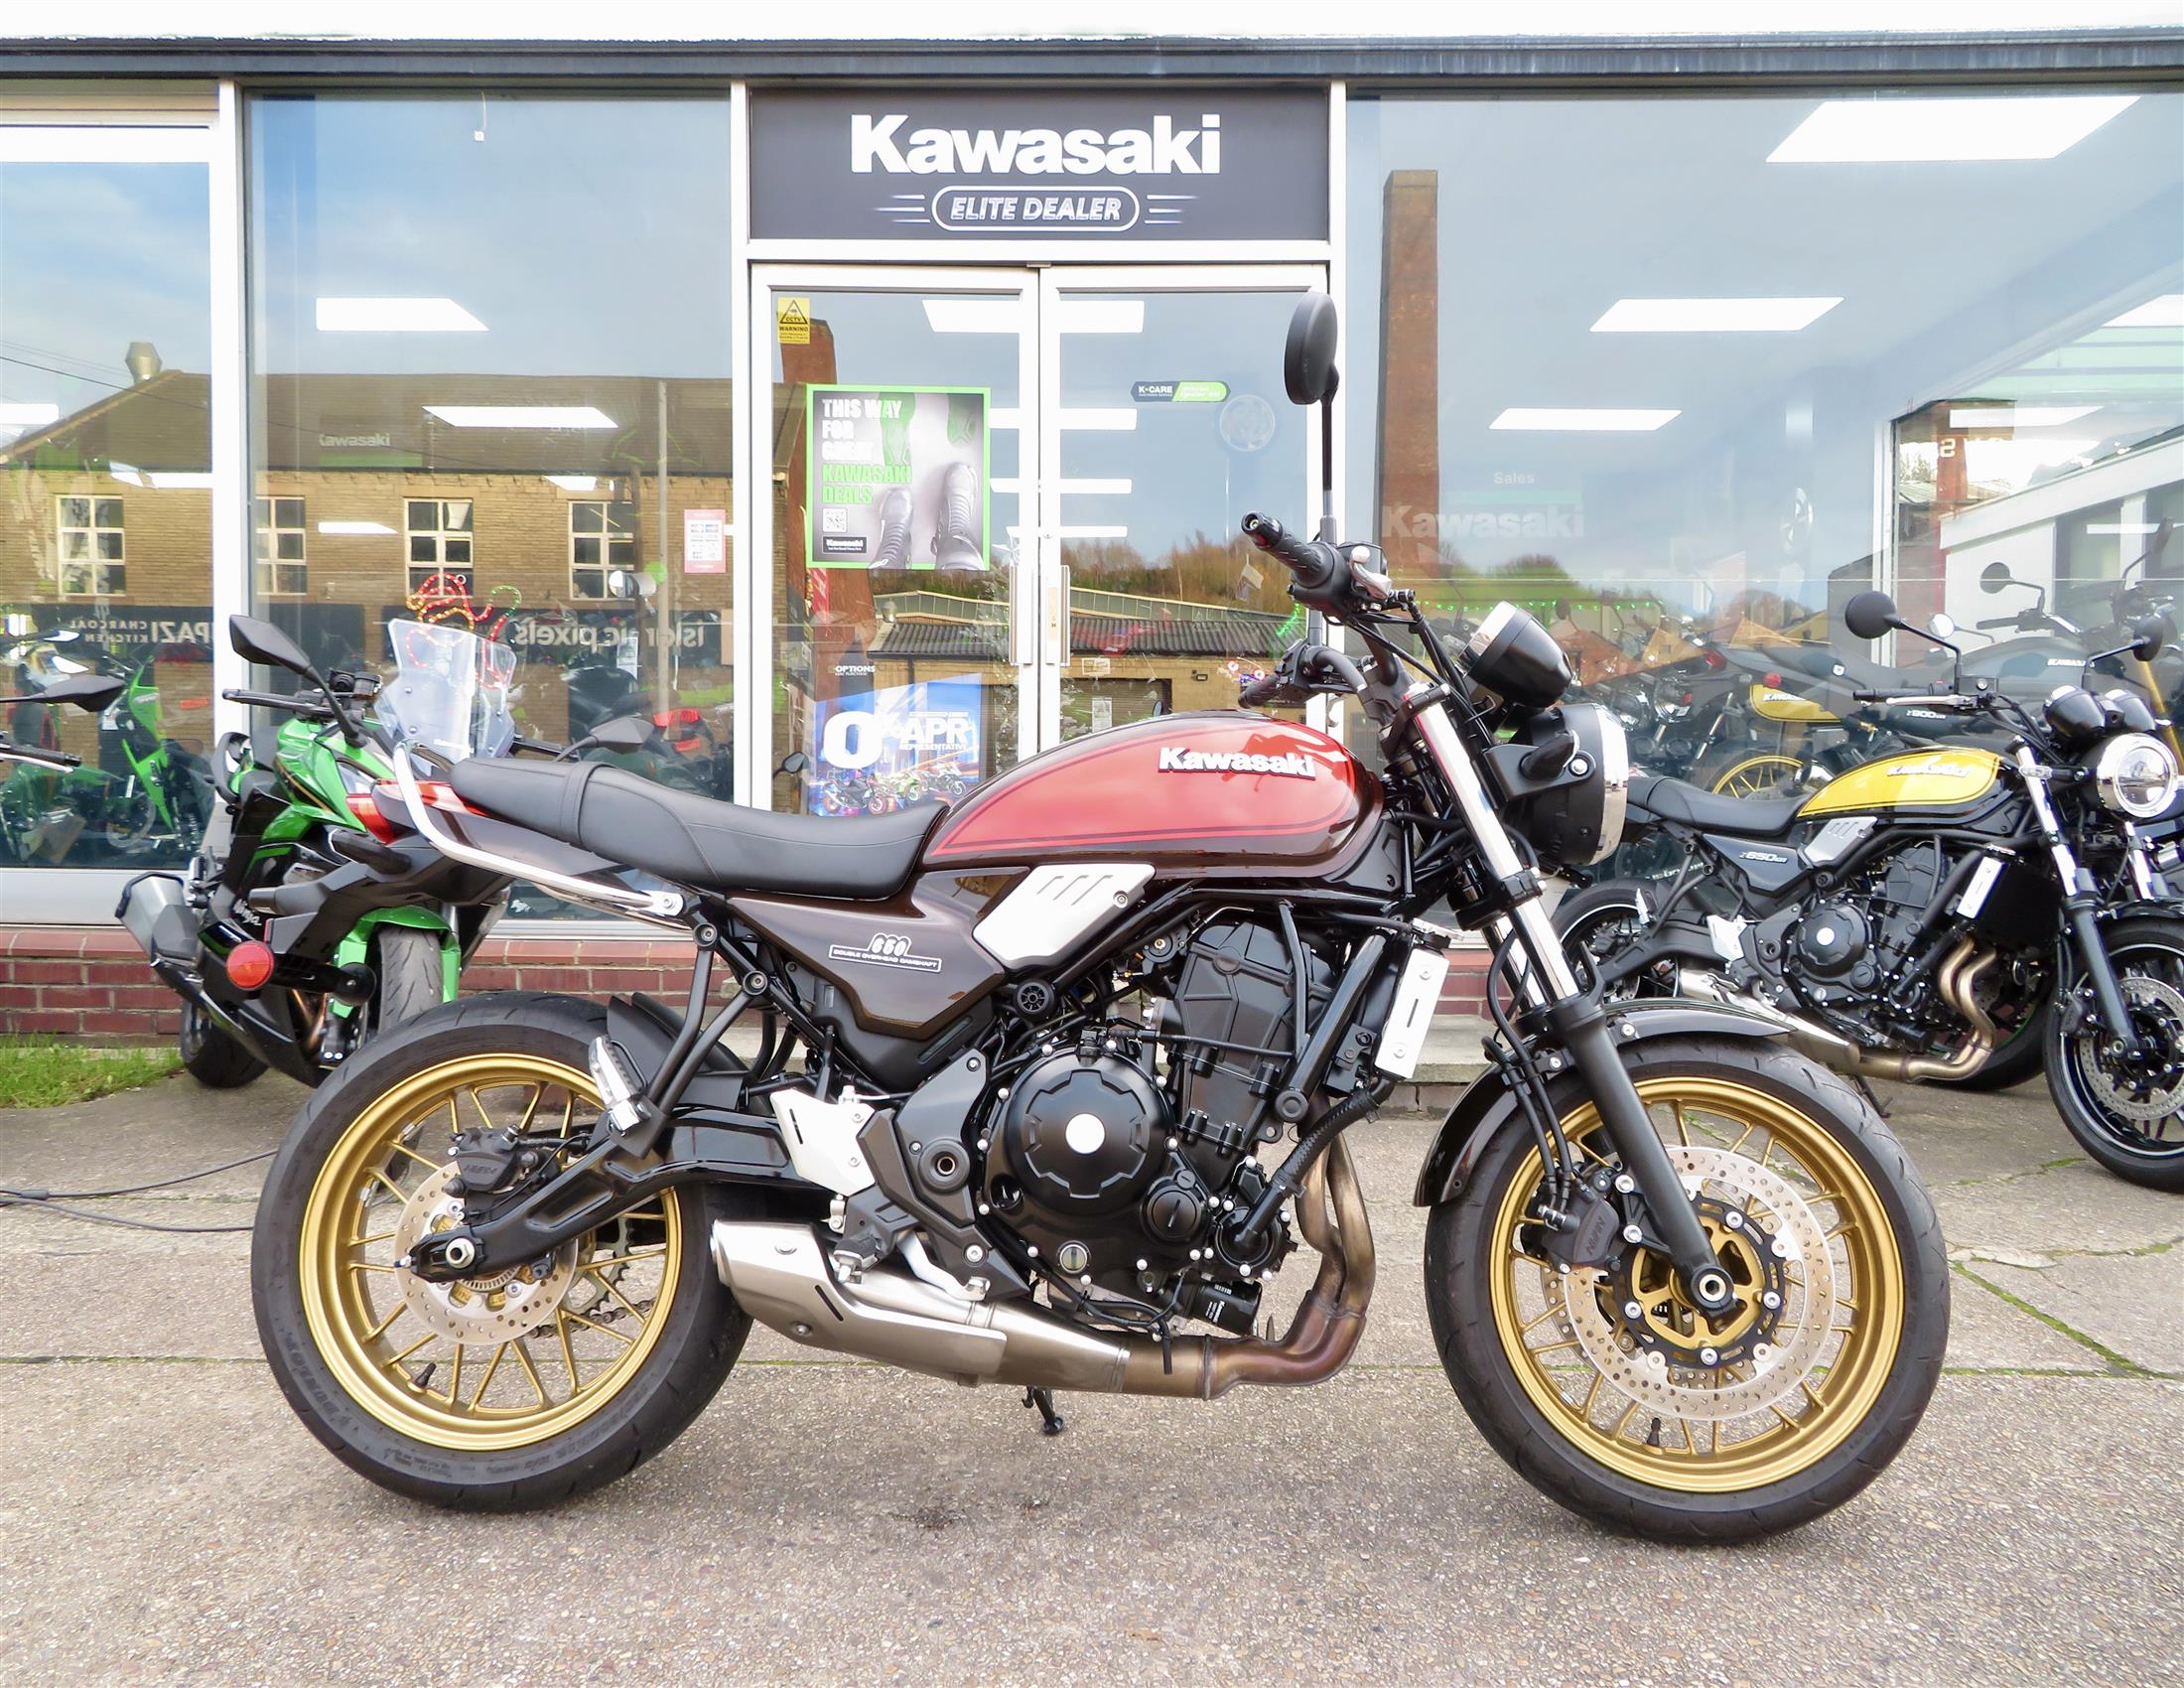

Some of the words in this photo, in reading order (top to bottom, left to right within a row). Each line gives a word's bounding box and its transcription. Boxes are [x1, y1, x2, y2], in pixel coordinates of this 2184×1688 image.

[851, 114, 1221, 175] Kawasaki
[950, 197, 1017, 220] ELITE
[1023, 197, 1122, 220] DEALER
[822, 398, 862, 418] THIS
[864, 399, 902, 419] WAY
[822, 419, 855, 440] FOR
[822, 463, 911, 484] KAWASAKI
[1493, 472, 1536, 485] Sales
[822, 484, 874, 504] DEALS
[1381, 504, 1585, 538] Kawasaki
[901, 717, 969, 744] APR
[1159, 747, 1316, 779] Kawasaki
[871, 937, 907, 956] 650
